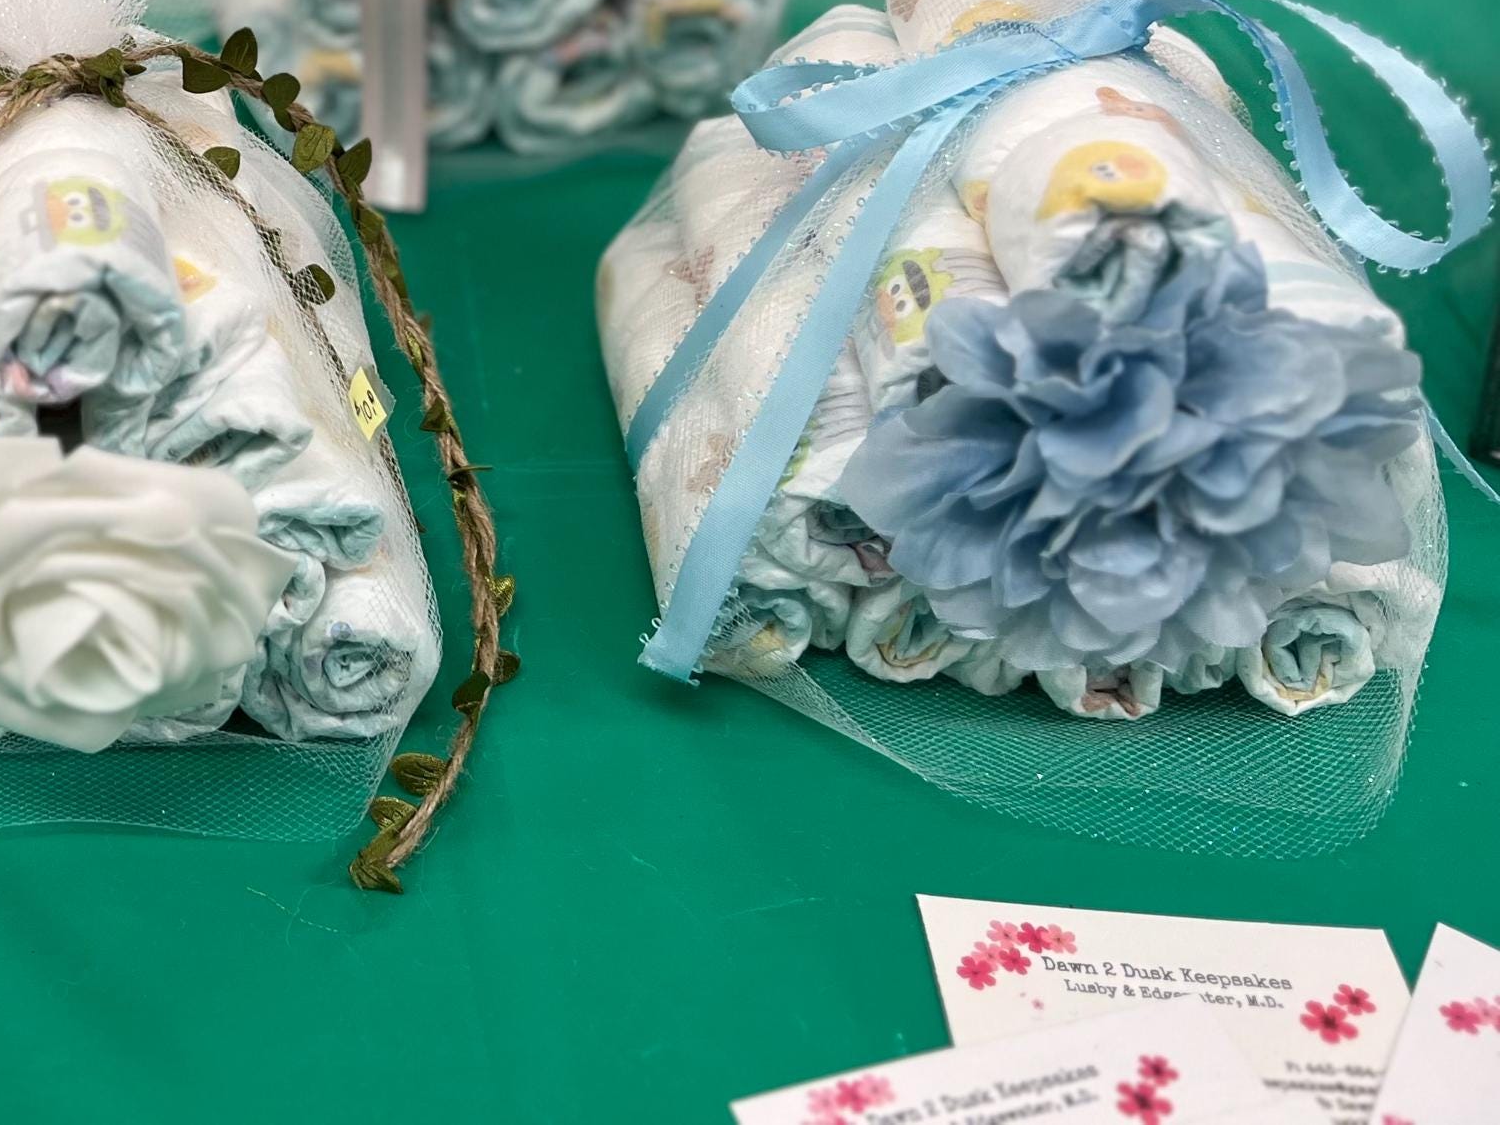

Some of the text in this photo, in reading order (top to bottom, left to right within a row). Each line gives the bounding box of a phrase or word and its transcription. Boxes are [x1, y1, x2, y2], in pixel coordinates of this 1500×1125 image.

[1041, 956, 1293, 990] Dawn 2 Dusk Keepsakes
[1064, 979, 1117, 999] Lusby
[1123, 984, 1136, 997] &
[1246, 994, 1285, 1009] M.D.
